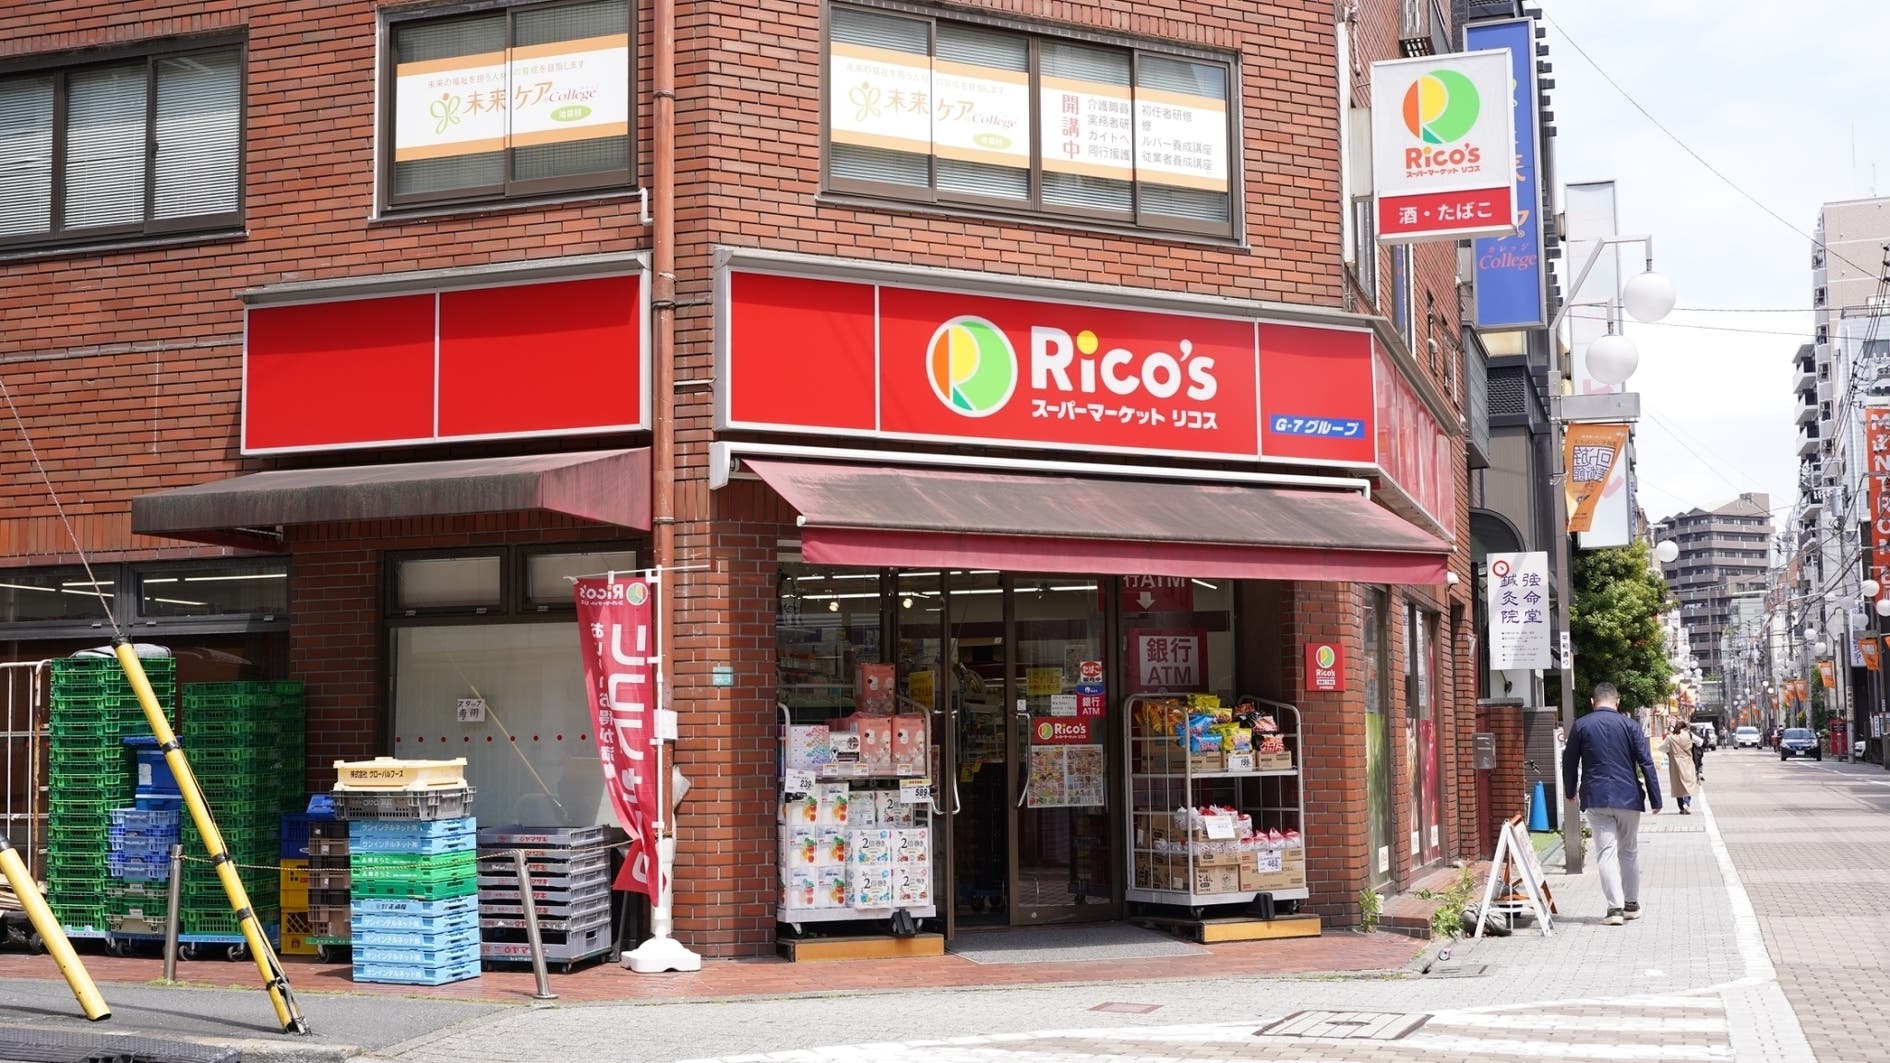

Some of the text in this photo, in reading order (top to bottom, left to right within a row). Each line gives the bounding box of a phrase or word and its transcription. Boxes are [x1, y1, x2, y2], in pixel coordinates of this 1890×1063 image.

[1062, 94, 1080, 160] 開講中
[1405, 143, 1480, 169] Rico's
[1406, 165, 1480, 178] スーパーマーケット リコス
[1479, 252, 1537, 271] College
[1031, 326, 1218, 401] Rico's
[1031, 399, 1218, 430] スーパーマーケット リコス
[1522, 572, 1543, 624] 強命堂
[1147, 638, 1192, 663] 銀行
[1148, 666, 1192, 684] ATM
[1316, 669, 1335, 677] Rico's
[1082, 696, 1101, 707] 銀行
[1082, 707, 1100, 716] ATM
[1054, 723, 1086, 735] Rico's
[915, 788, 928, 797] 589
